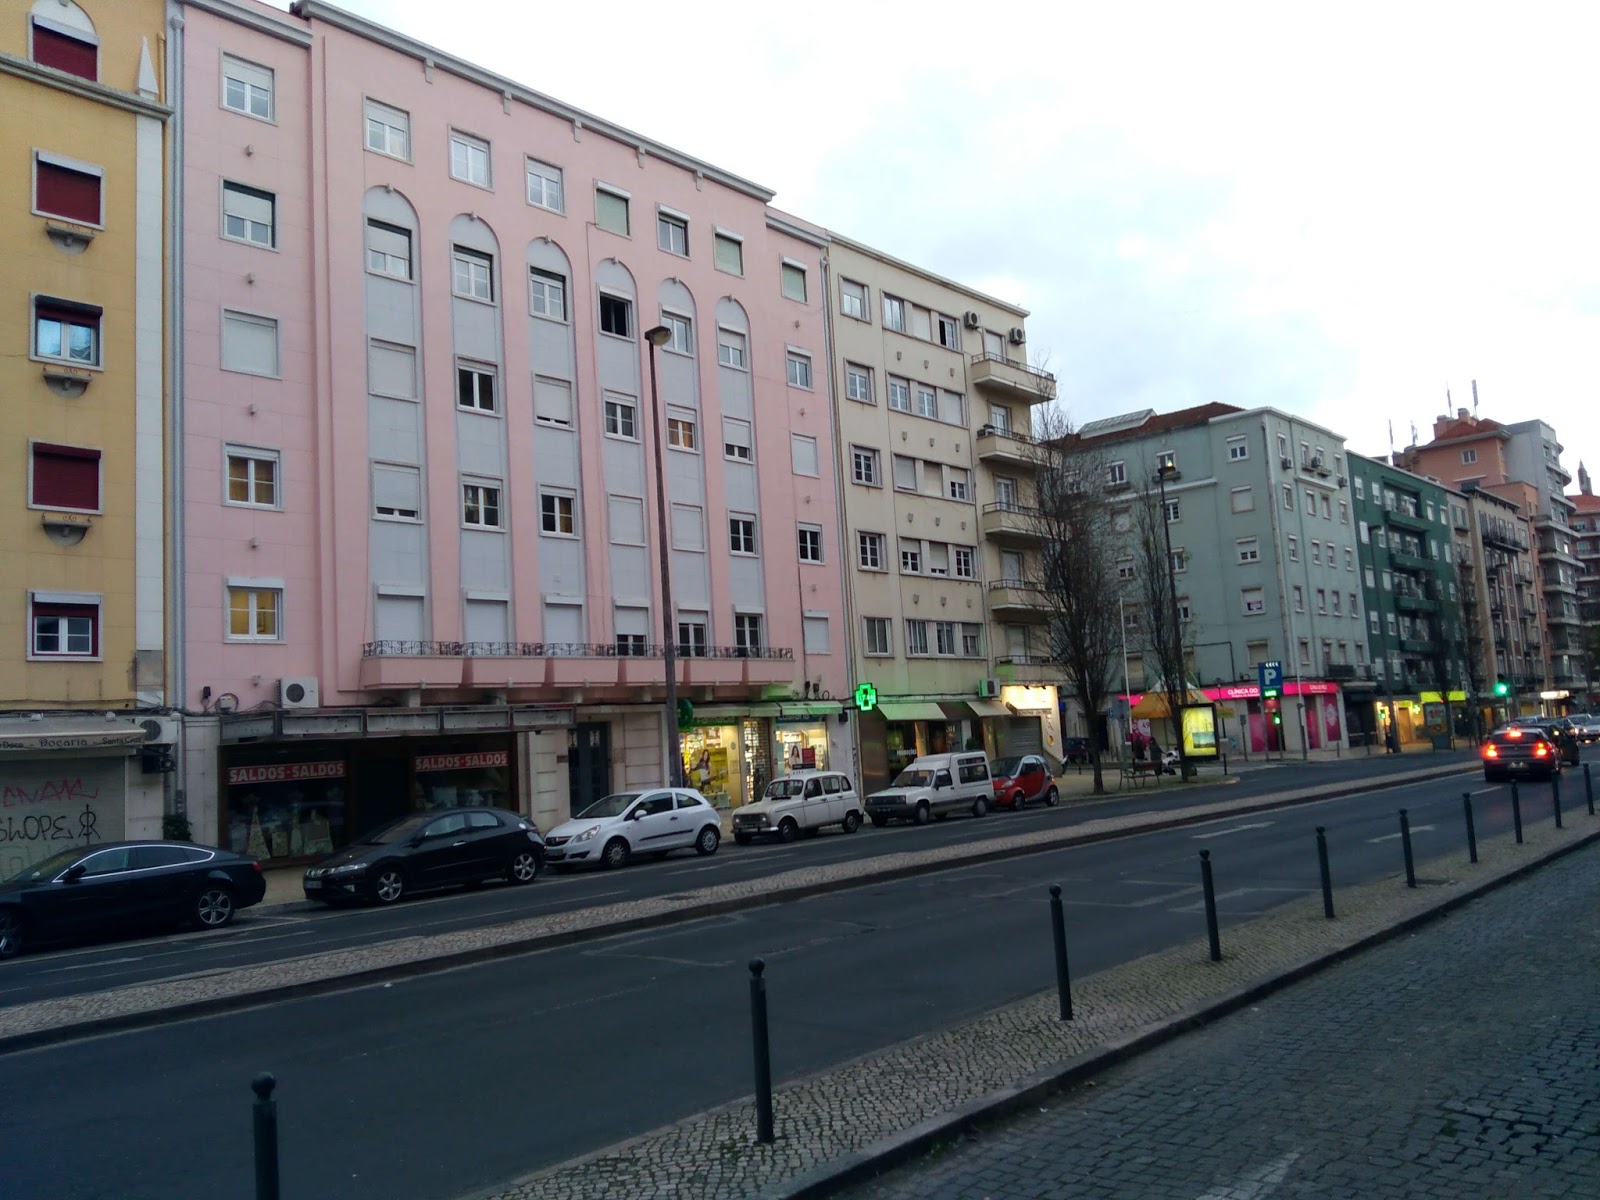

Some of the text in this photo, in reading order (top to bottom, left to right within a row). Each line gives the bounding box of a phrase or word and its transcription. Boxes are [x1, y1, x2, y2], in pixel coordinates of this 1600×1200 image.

[1264, 668, 1277, 686] P
[415, 753, 508, 771] SALDOS SALDOS
[229, 762, 345, 783] SALDOS SALDOS
